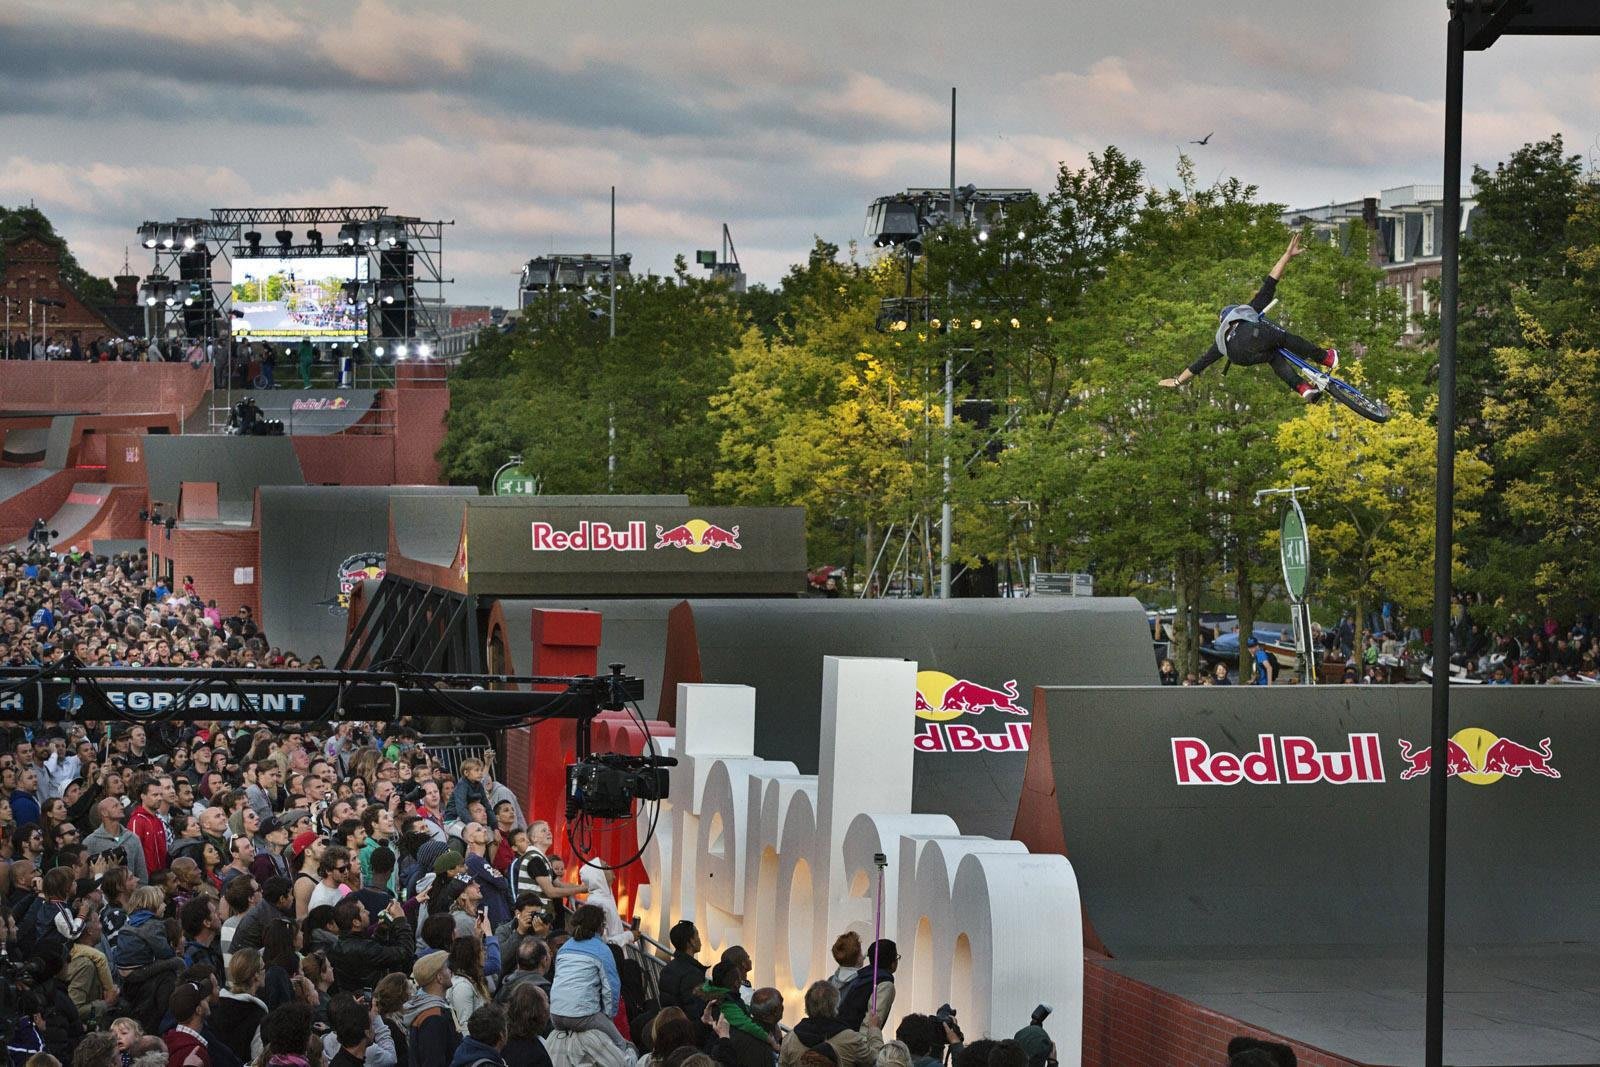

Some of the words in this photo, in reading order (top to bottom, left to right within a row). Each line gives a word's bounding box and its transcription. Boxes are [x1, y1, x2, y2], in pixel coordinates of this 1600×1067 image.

[532, 521, 589, 550] Red
[591, 521, 646, 550] Bull
[107, 691, 305, 711] EGRIPMENT
[945, 722, 1032, 752] Bull
[1171, 734, 1281, 785] Red
[1280, 733, 1386, 784] Bull
